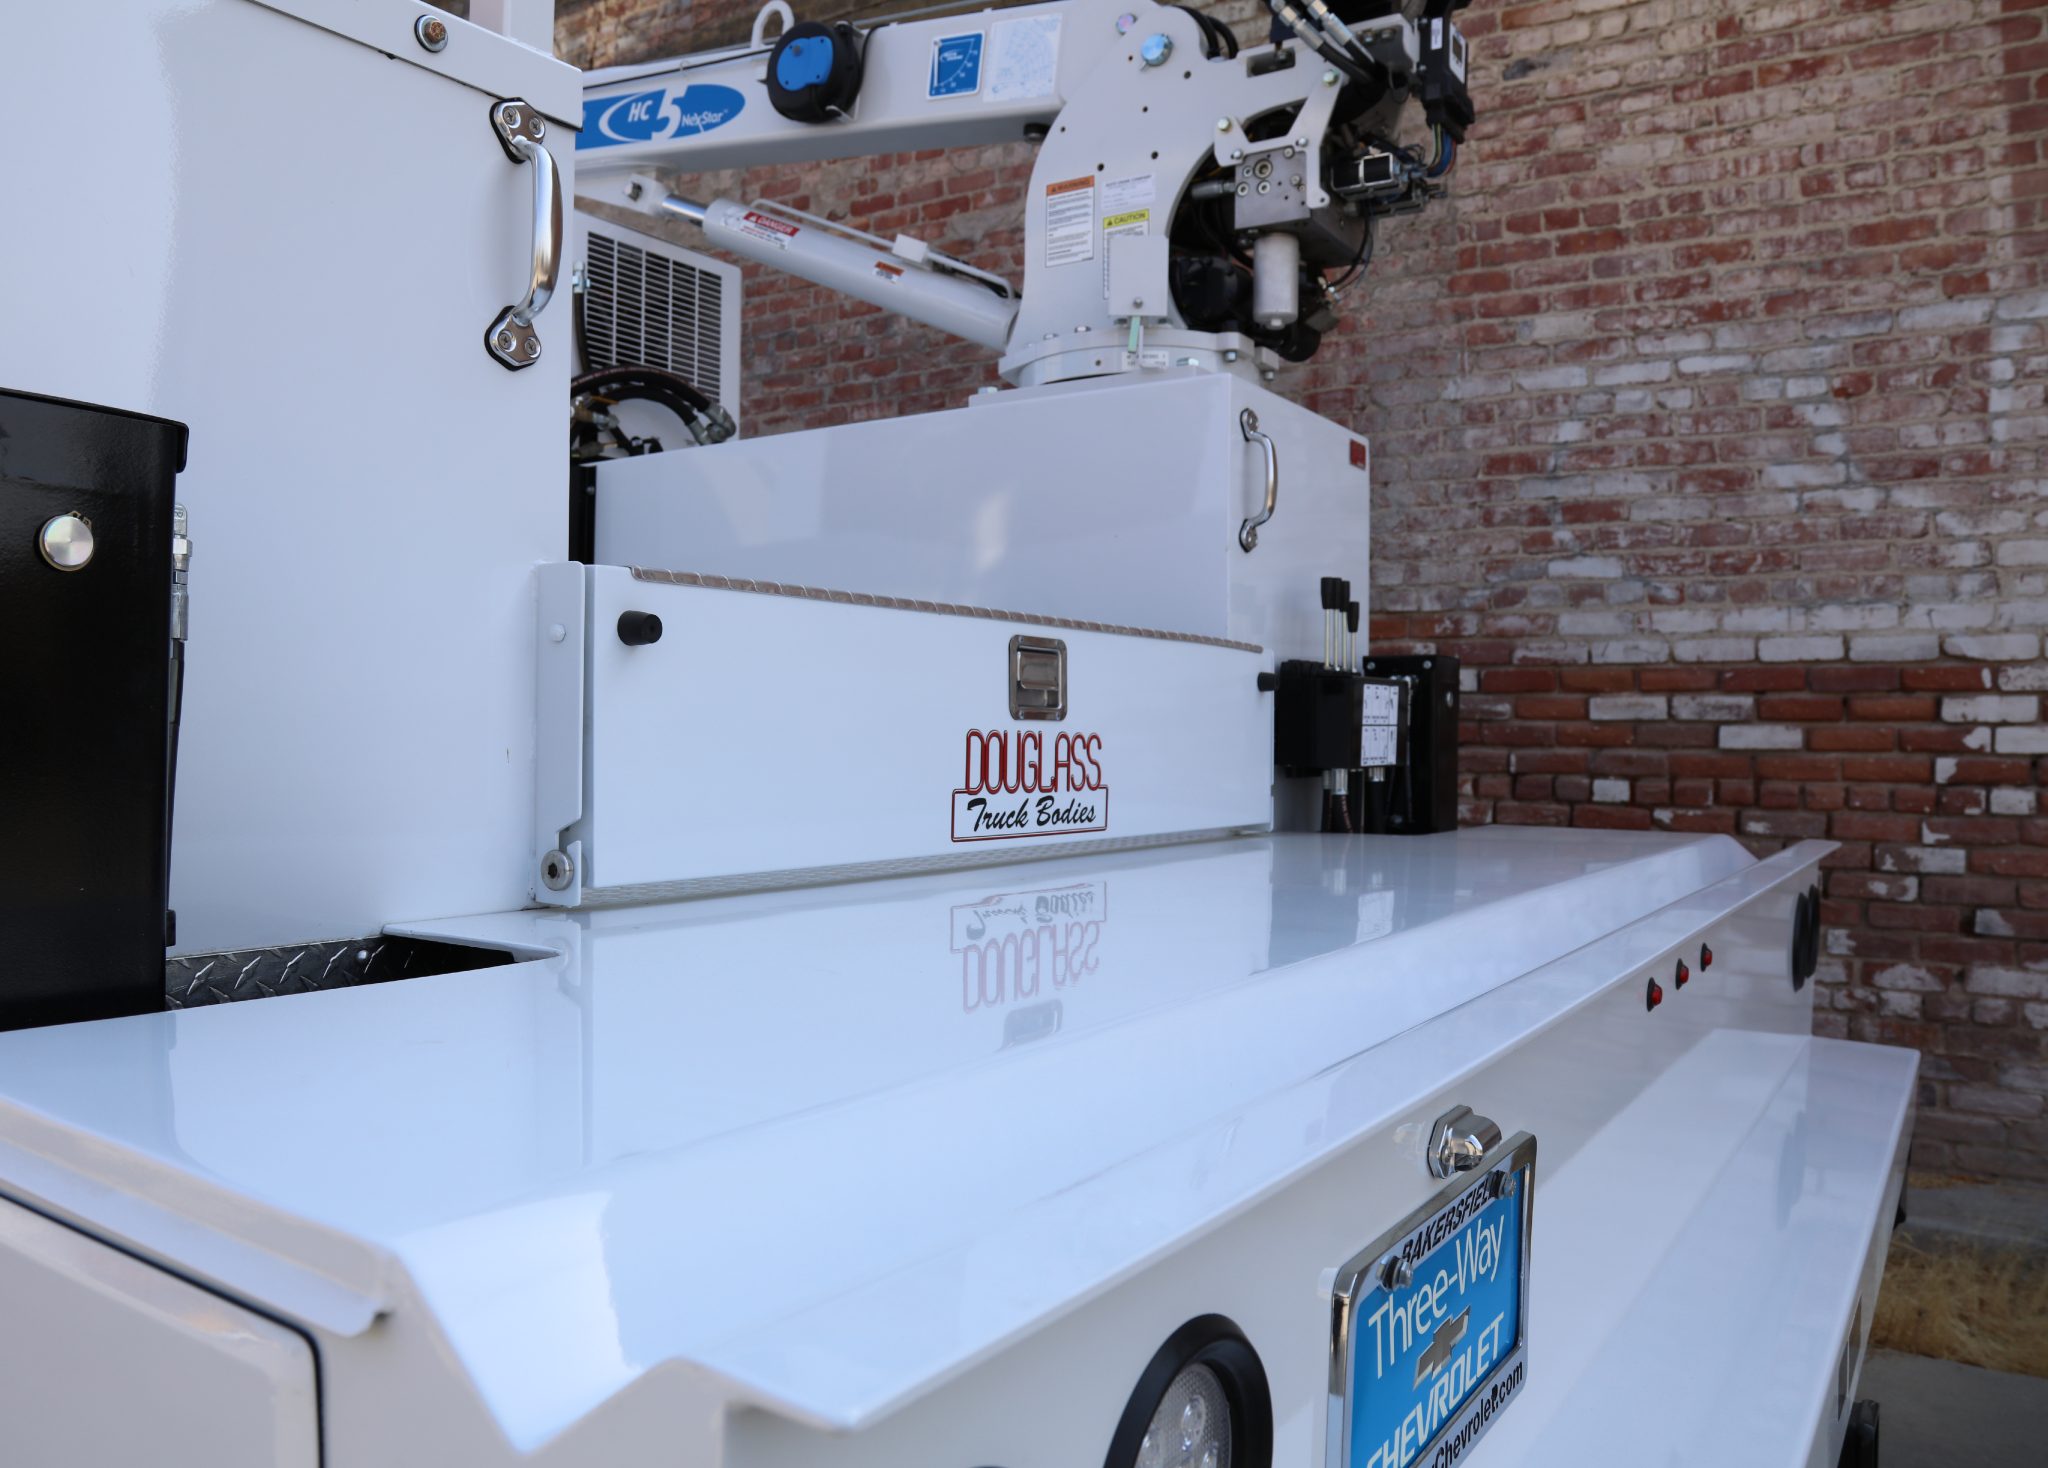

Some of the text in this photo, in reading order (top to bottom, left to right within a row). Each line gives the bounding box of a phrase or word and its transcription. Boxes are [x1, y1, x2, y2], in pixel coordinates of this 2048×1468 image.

[628, 84, 690, 141] HC 5
[761, 214, 795, 235] DANGER
[1114, 212, 1146, 224] CAUTION
[966, 728, 1102, 795] DOUGLASS
[967, 795, 1097, 832] Truck Bodies
[1402, 1176, 1496, 1264] BAKERSFIEL
[1368, 1214, 1505, 1380] Three-Way
